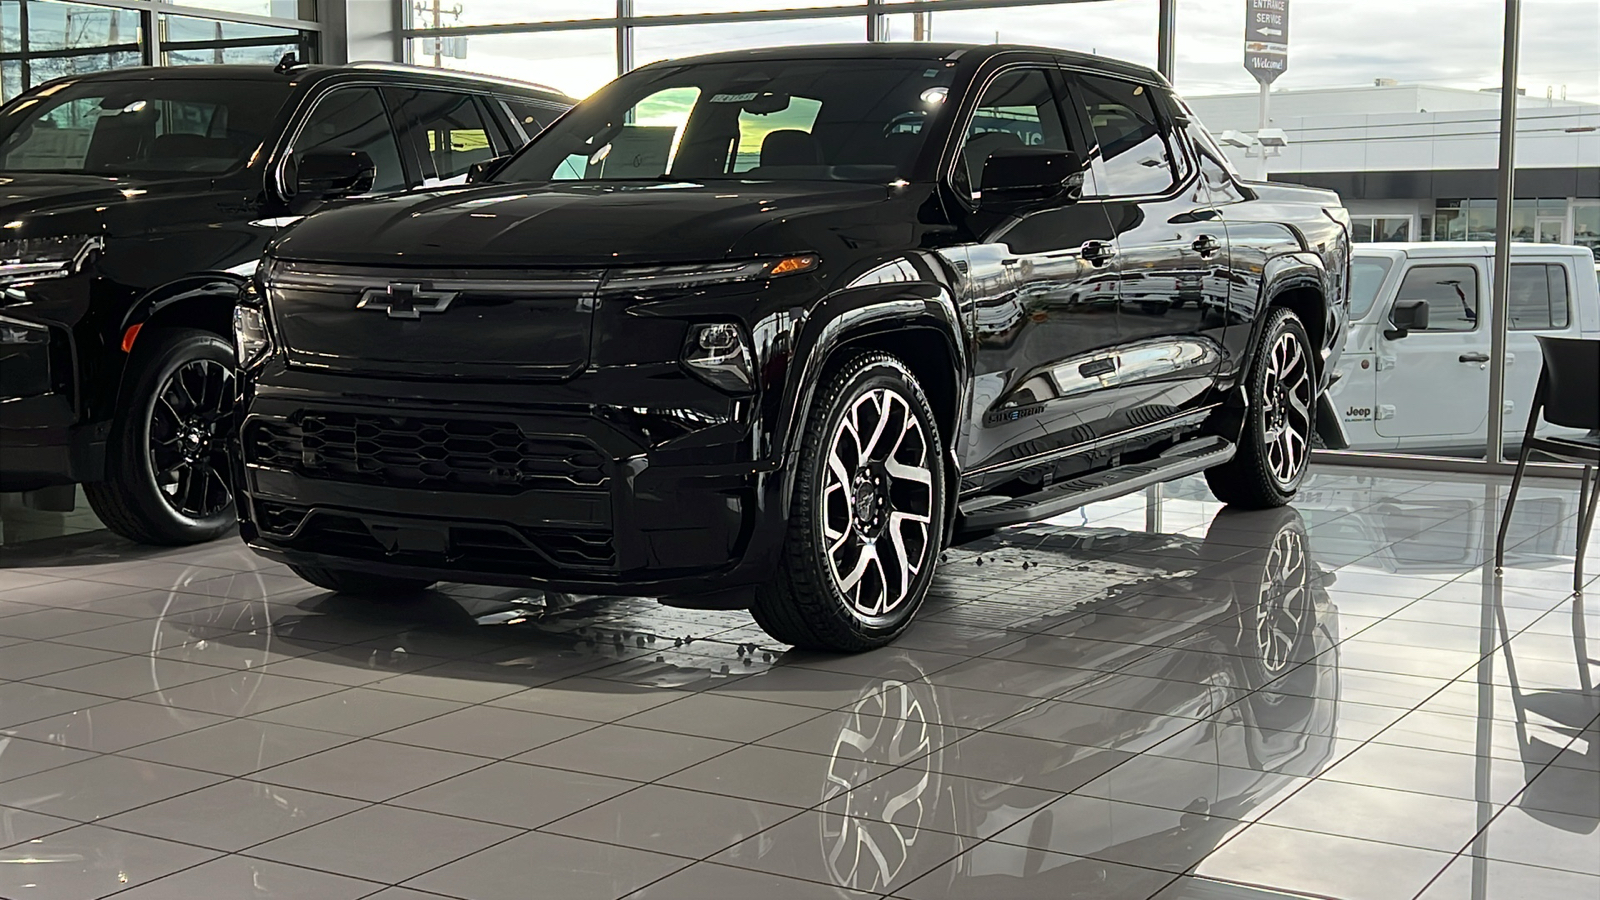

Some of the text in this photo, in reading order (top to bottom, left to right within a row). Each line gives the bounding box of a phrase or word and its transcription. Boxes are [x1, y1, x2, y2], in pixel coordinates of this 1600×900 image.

[1253, 0, 1285, 11] ENTRANCE
[1256, 13, 1282, 25] SERVICE
[1346, 406, 1371, 418] Jeep
